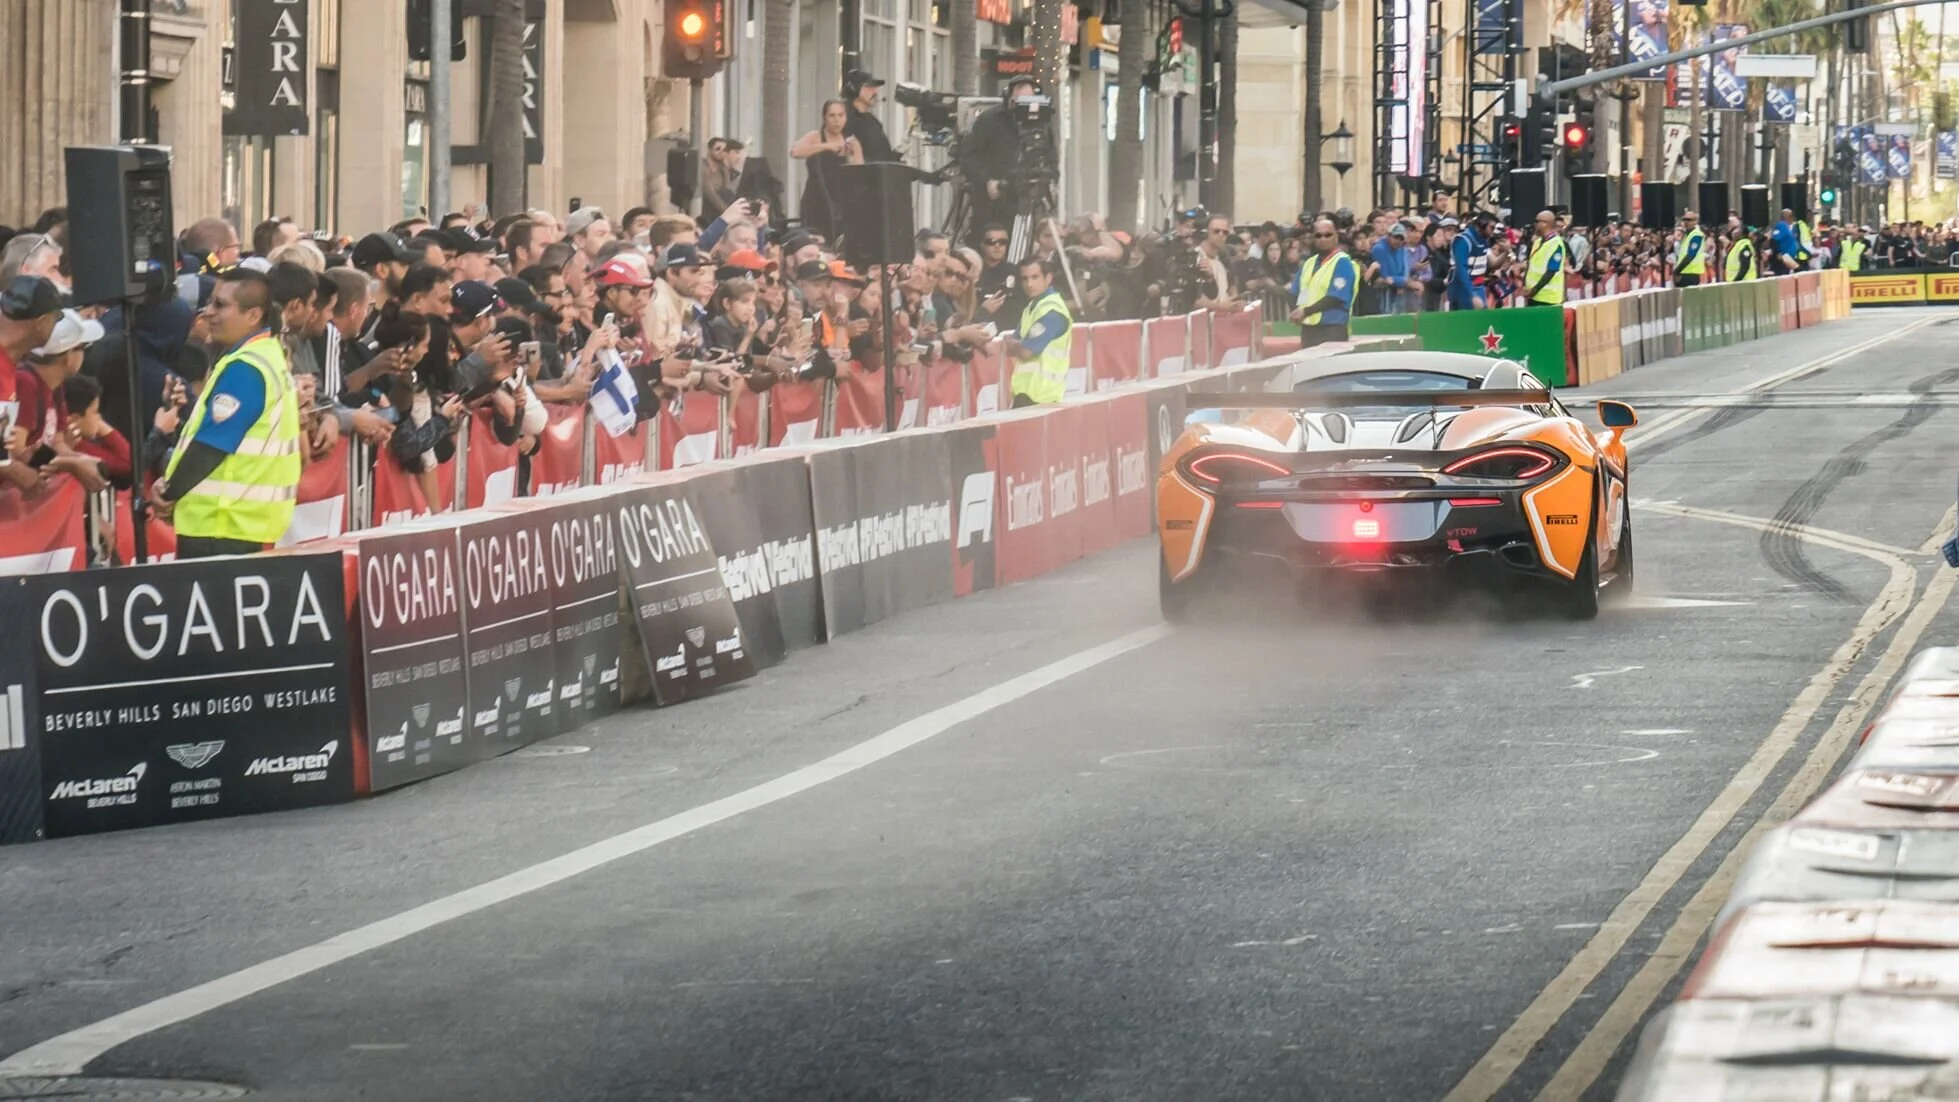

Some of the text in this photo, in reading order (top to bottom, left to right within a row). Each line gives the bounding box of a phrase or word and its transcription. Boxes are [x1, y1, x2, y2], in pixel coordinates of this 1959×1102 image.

[269, 0, 301, 106] ARA
[1849, 279, 1917, 298] PIRELLI
[466, 528, 548, 609] O'GARA
[551, 512, 617, 587] O'GARA
[620, 496, 709, 568] O'GARA
[41, 569, 332, 667] O'GARA
[366, 547, 457, 628] O'GARA
[45, 686, 337, 732] BEVERLY HILLS SAN DIEGO WESTLAKE
[49, 776, 137, 800] McLaren
[244, 753, 329, 776] McLaren
